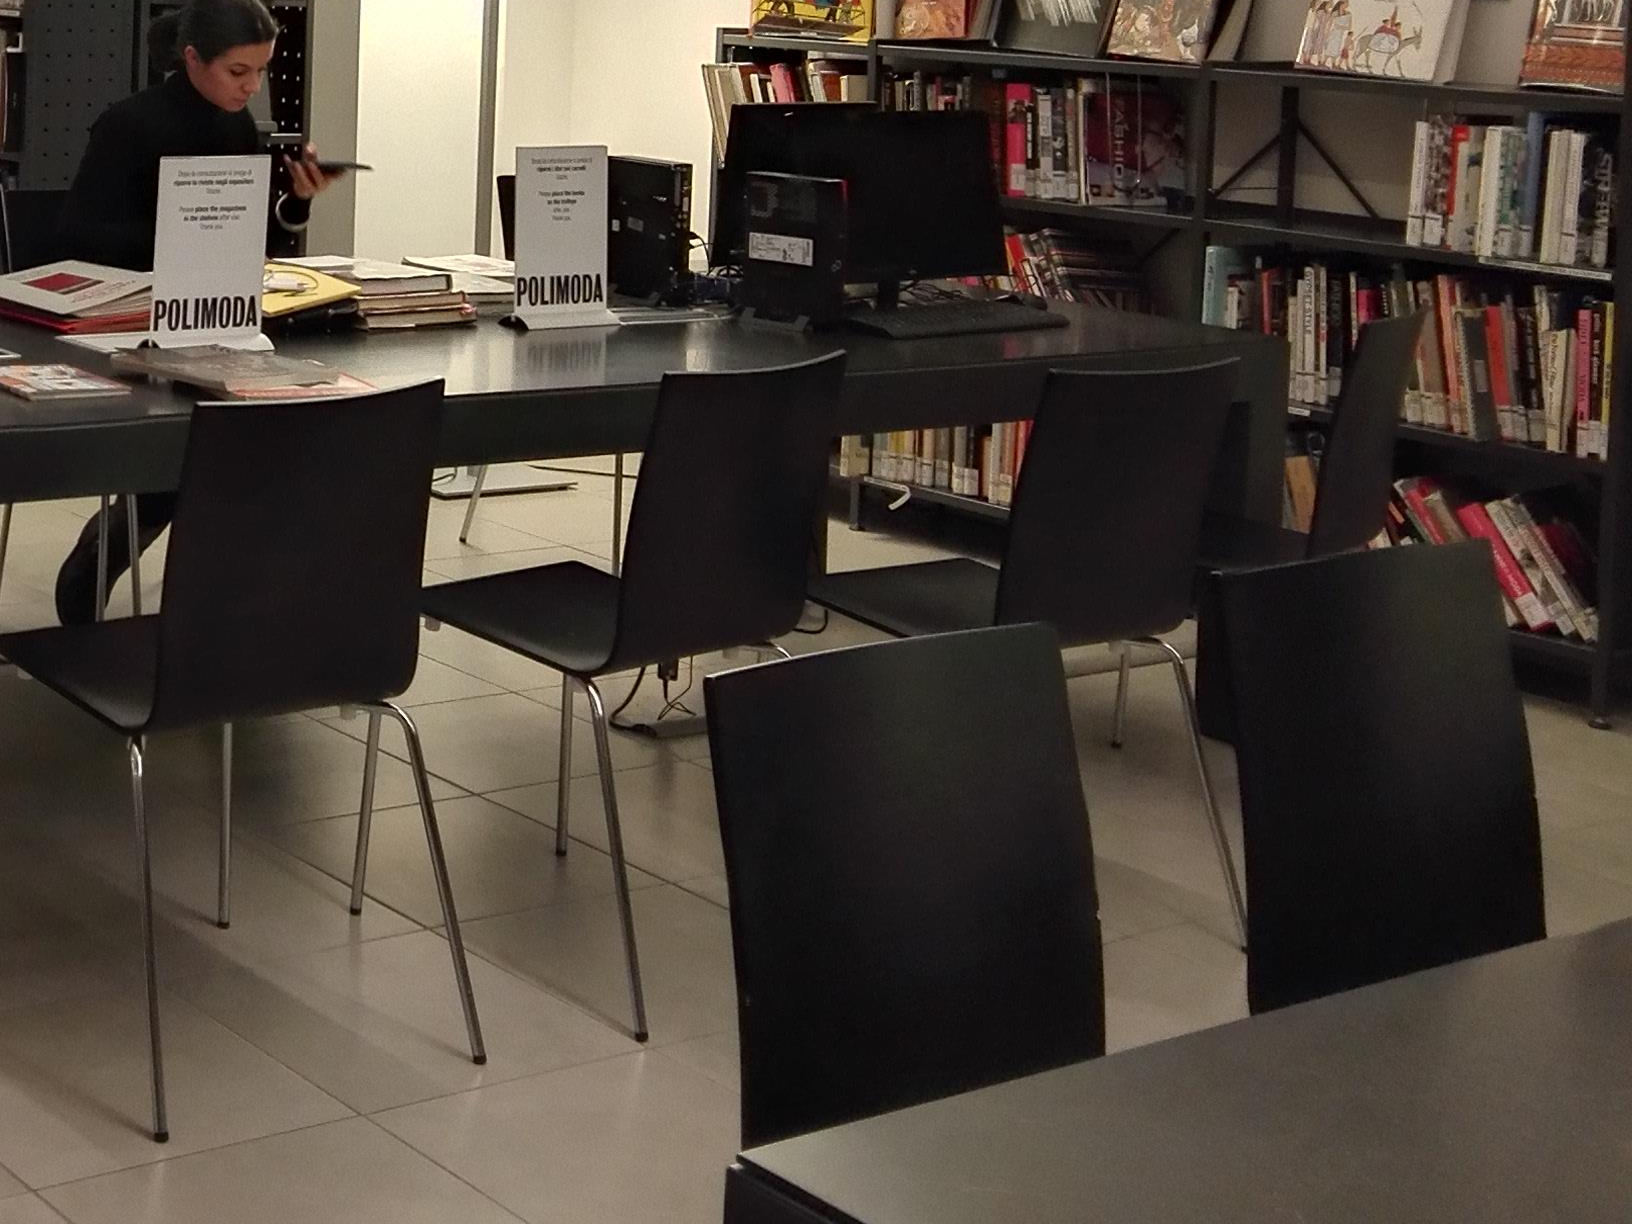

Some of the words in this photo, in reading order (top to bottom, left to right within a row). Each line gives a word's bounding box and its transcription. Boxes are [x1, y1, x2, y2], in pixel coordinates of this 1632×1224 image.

[516, 273, 604, 307] POLIMODA
[153, 295, 258, 332] POLIMODA
[1304, 307, 1312, 335] STYLE
